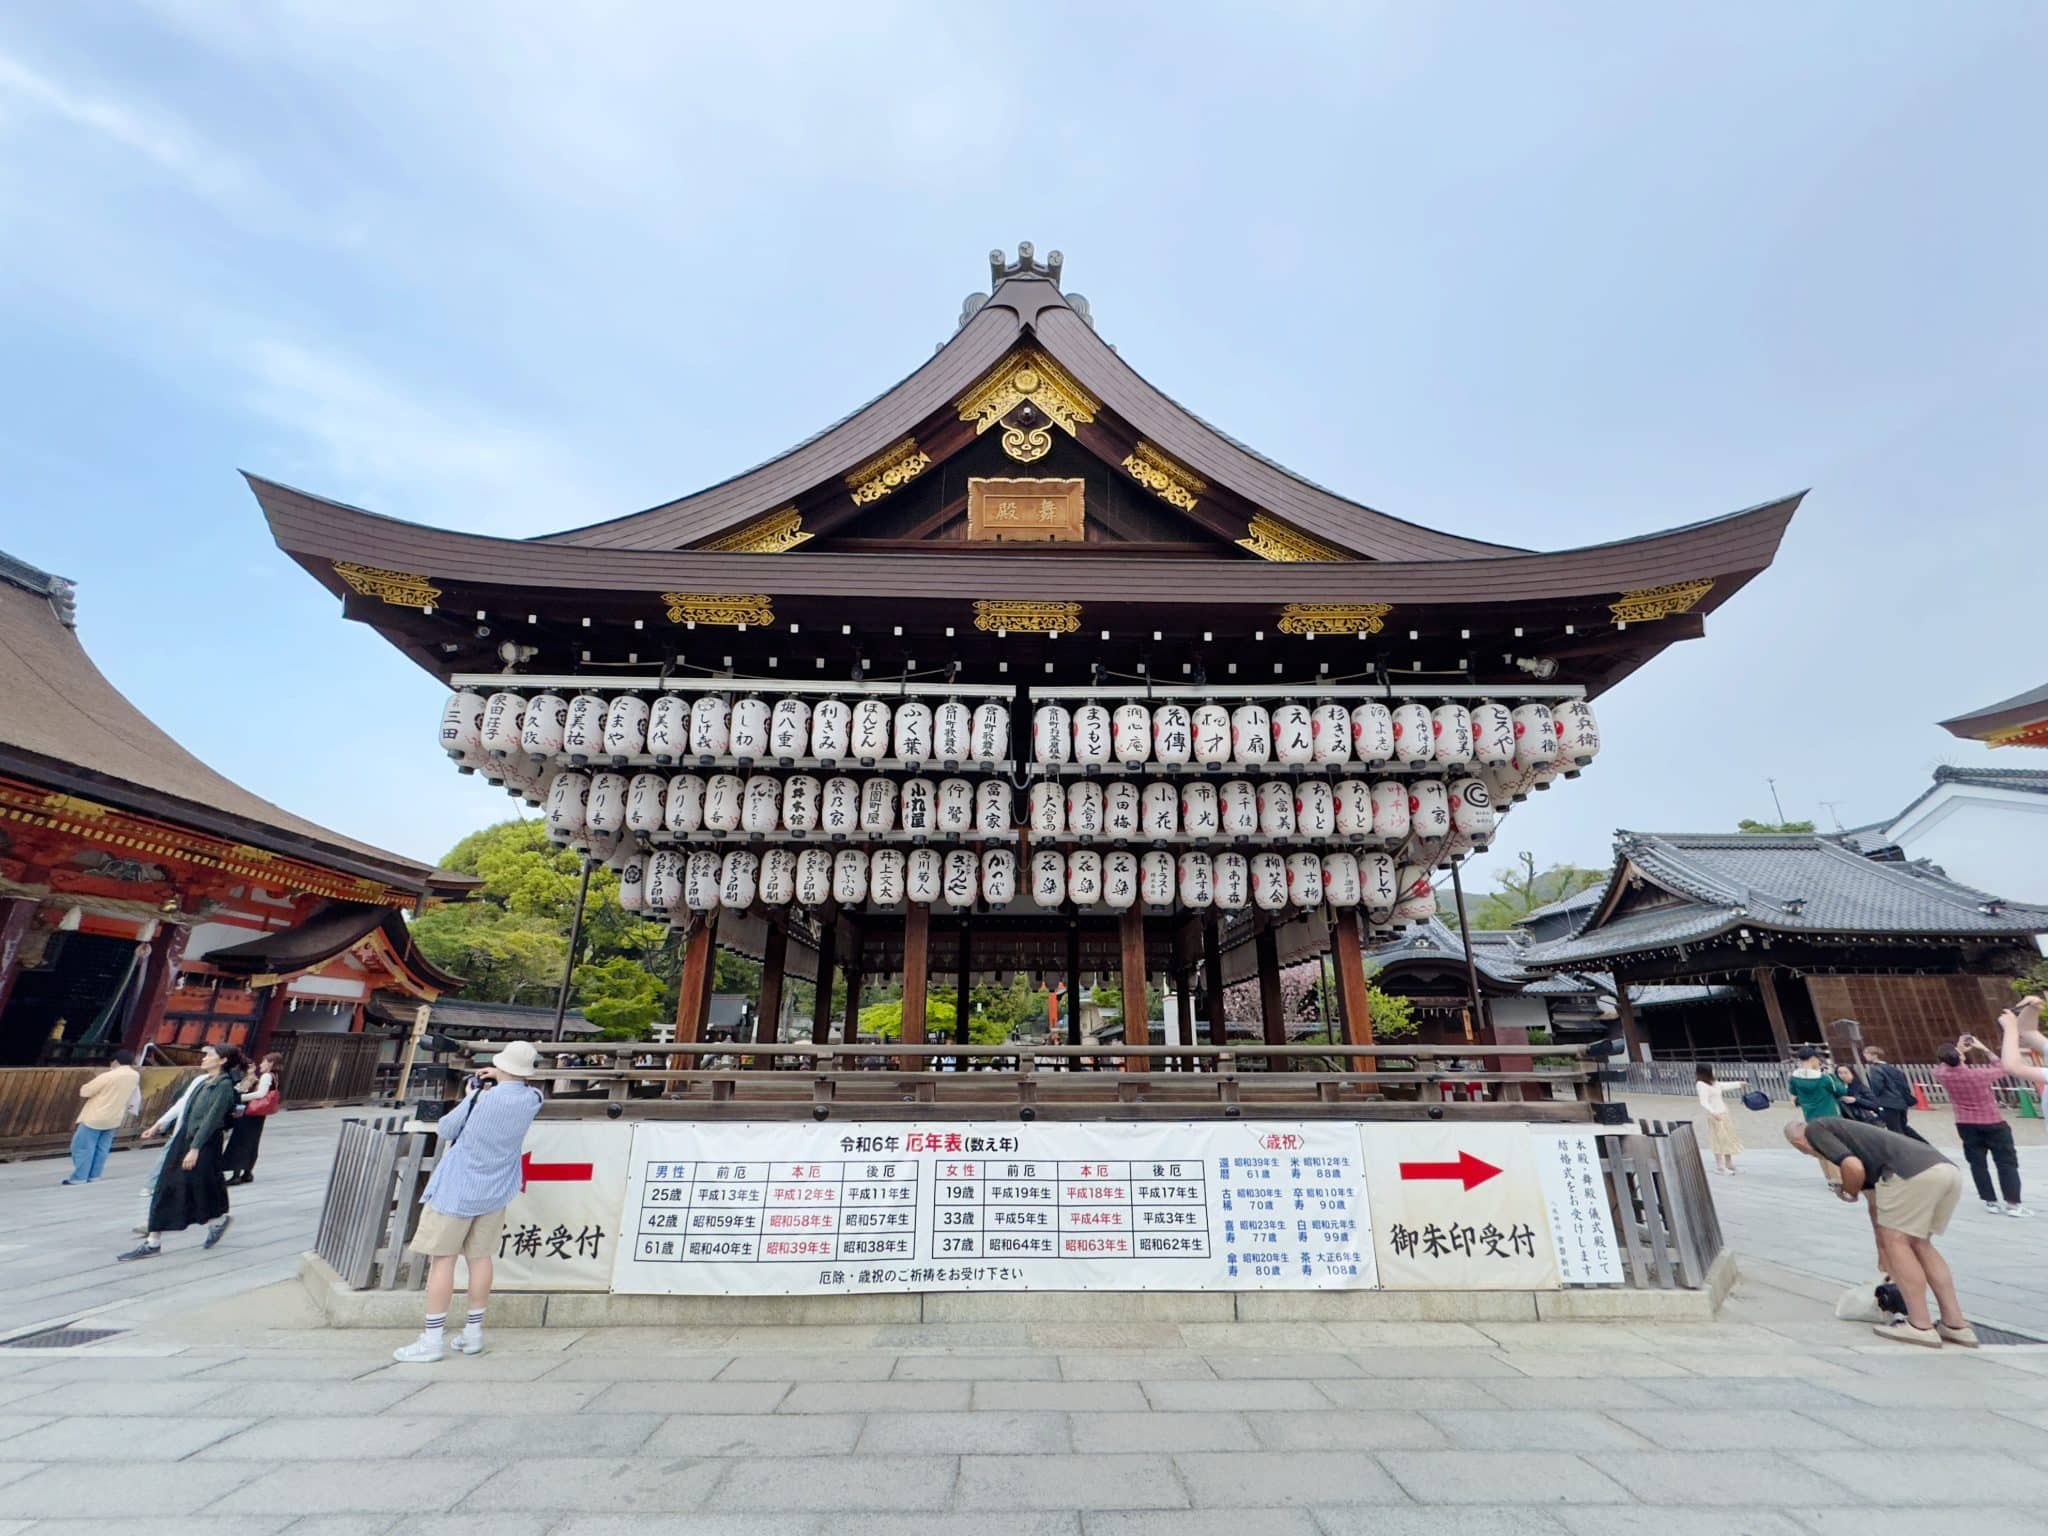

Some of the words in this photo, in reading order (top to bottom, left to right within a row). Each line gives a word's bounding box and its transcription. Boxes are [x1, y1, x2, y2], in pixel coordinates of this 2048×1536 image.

[608, 698, 628, 746] たまや
[778, 702, 797, 748] 堀八重
[819, 704, 838, 749] 利きみ
[904, 705, 922, 755] ふく葉
[1087, 708, 1102, 755] まつもと
[1247, 711, 1264, 754] 小扇
[1328, 707, 1346, 753] 杉きみ
[984, 782, 1002, 829] 富久家
[1113, 785, 1132, 829] 上田梅
[1155, 787, 1172, 830] 小花
[1195, 785, 1215, 827] 市光
[1273, 783, 1291, 830] 久富美
[1312, 784, 1326, 830] ちもと
[1352, 783, 1365, 828] ちもと
[1427, 784, 1448, 824] 叶家
[1374, 856, 1392, 899] カトレヤ
[840, 1137, 900, 1153] 令和6年
[1234, 1157, 1280, 1167] 昭和39年生
[1303, 1157, 1351, 1167] 昭和12年生
[651, 1188, 682, 1201] 25歳
[697, 1188, 759, 1202] 平成13年生
[773, 1188, 835, 1201] 平成12年生
[848, 1187, 910, 1201] 平成11年生
[946, 1185, 975, 1199] 19歳
[991, 1186, 1052, 1200] 平成19年生
[1066, 1186, 1126, 1199] 平成18年生
[1138, 1186, 1199, 1199] 平成17年生
[1237, 1188, 1283, 1198] 昭和30年生
[1306, 1188, 1355, 1198] 昭和10年生
[648, 1214, 678, 1228] 42歳
[692, 1215, 756, 1229] 昭和59年生
[769, 1214, 833, 1228] 昭和58年生
[846, 1212, 909, 1227] 昭和57年生
[943, 1211, 975, 1225] 33歳
[994, 1212, 1049, 1225] 平成5年生
[1070, 1211, 1123, 1225] 平成4年生
[1143, 1211, 1197, 1225] 平成3年生
[1240, 1220, 1287, 1230] 昭和23年生
[1312, 1219, 1357, 1229] 昭和元年生
[644, 1241, 675, 1255] 61歳
[689, 1241, 753, 1256] 昭和40年生
[767, 1240, 831, 1255] 昭和39年生
[843, 1239, 908, 1253] 昭和38年生
[943, 1238, 975, 1252] 37歳
[989, 1237, 1052, 1252] 昭和64年生
[1065, 1238, 1129, 1252] 昭和63年生
[1140, 1237, 1203, 1251] 昭和62年生
[1243, 1253, 1289, 1263] 昭和20年生
[1316, 1252, 1361, 1263] 大正6年生
[1390, 1221, 1536, 1259] 御朱印受付
